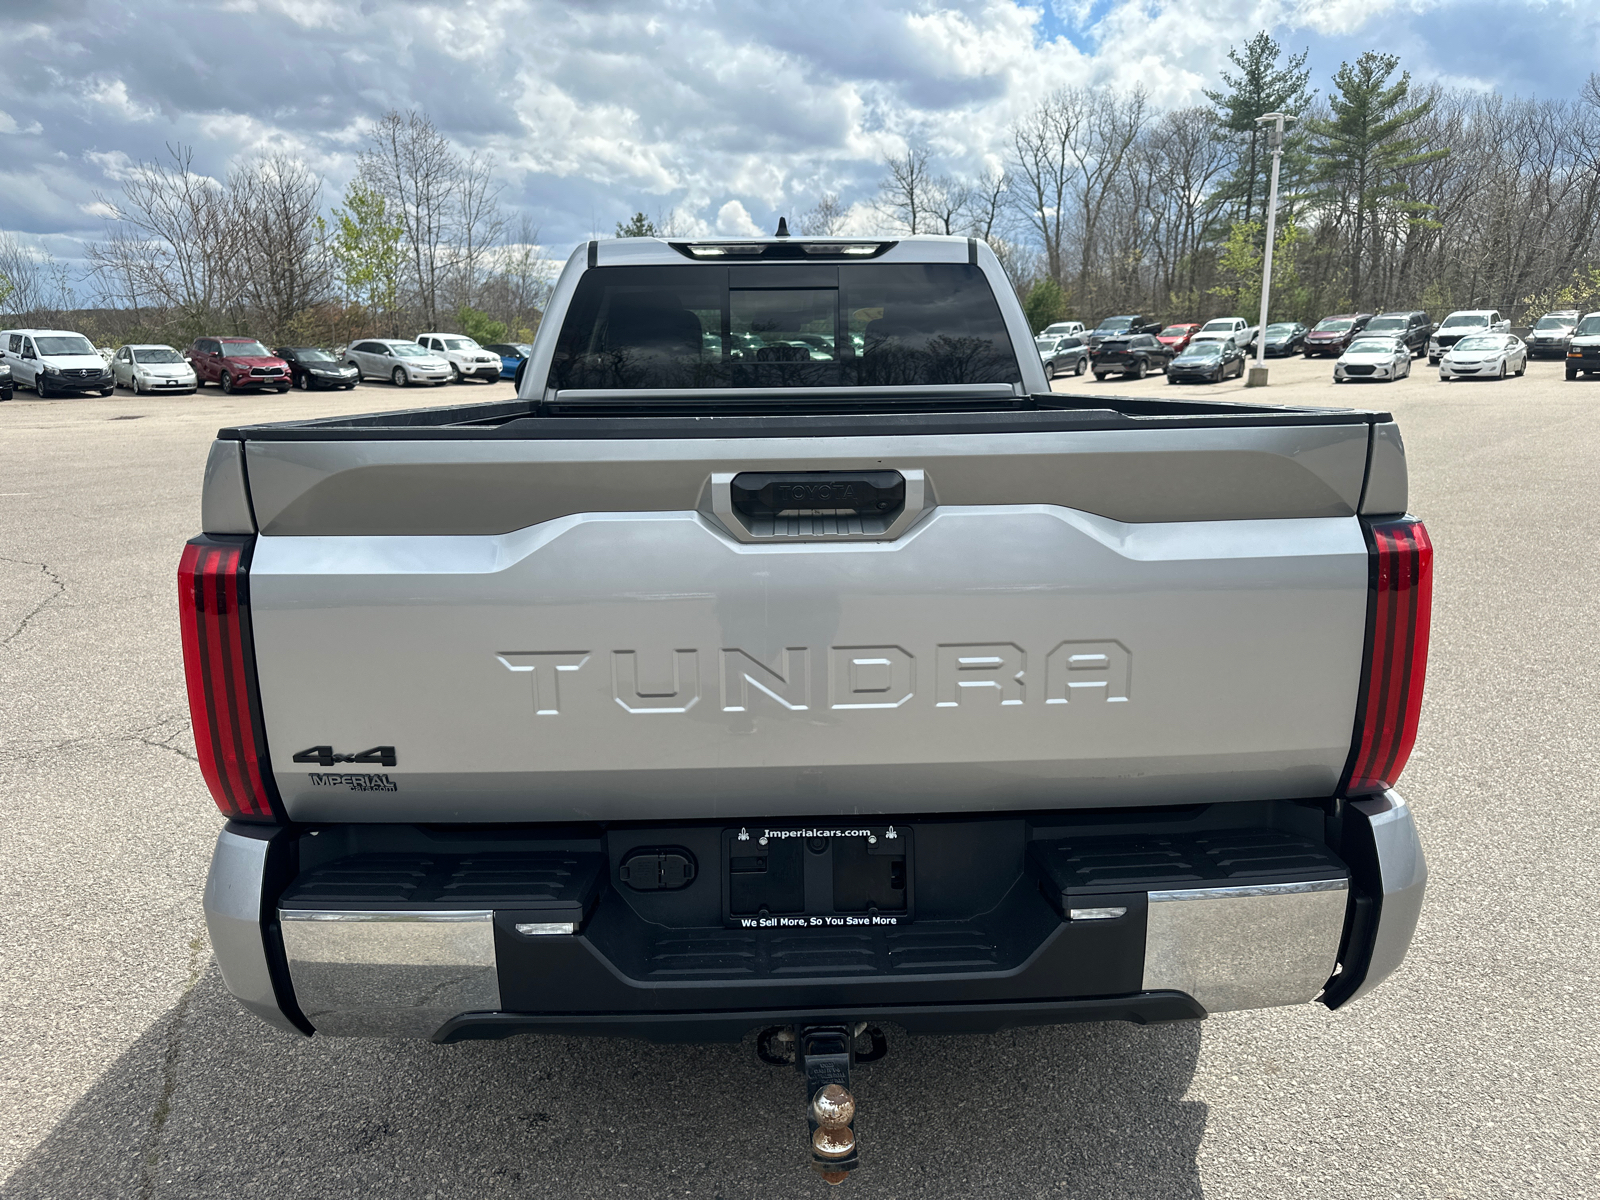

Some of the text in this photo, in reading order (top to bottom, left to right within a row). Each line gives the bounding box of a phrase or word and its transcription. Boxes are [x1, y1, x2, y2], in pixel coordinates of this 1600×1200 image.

[778, 484, 858, 501] TOYOTA
[494, 638, 1132, 715] TUNDRA
[308, 772, 397, 787] IMPERIAL
[764, 828, 871, 839] Imperialcars.com
[741, 916, 897, 928] We Sell More, So You Save More
